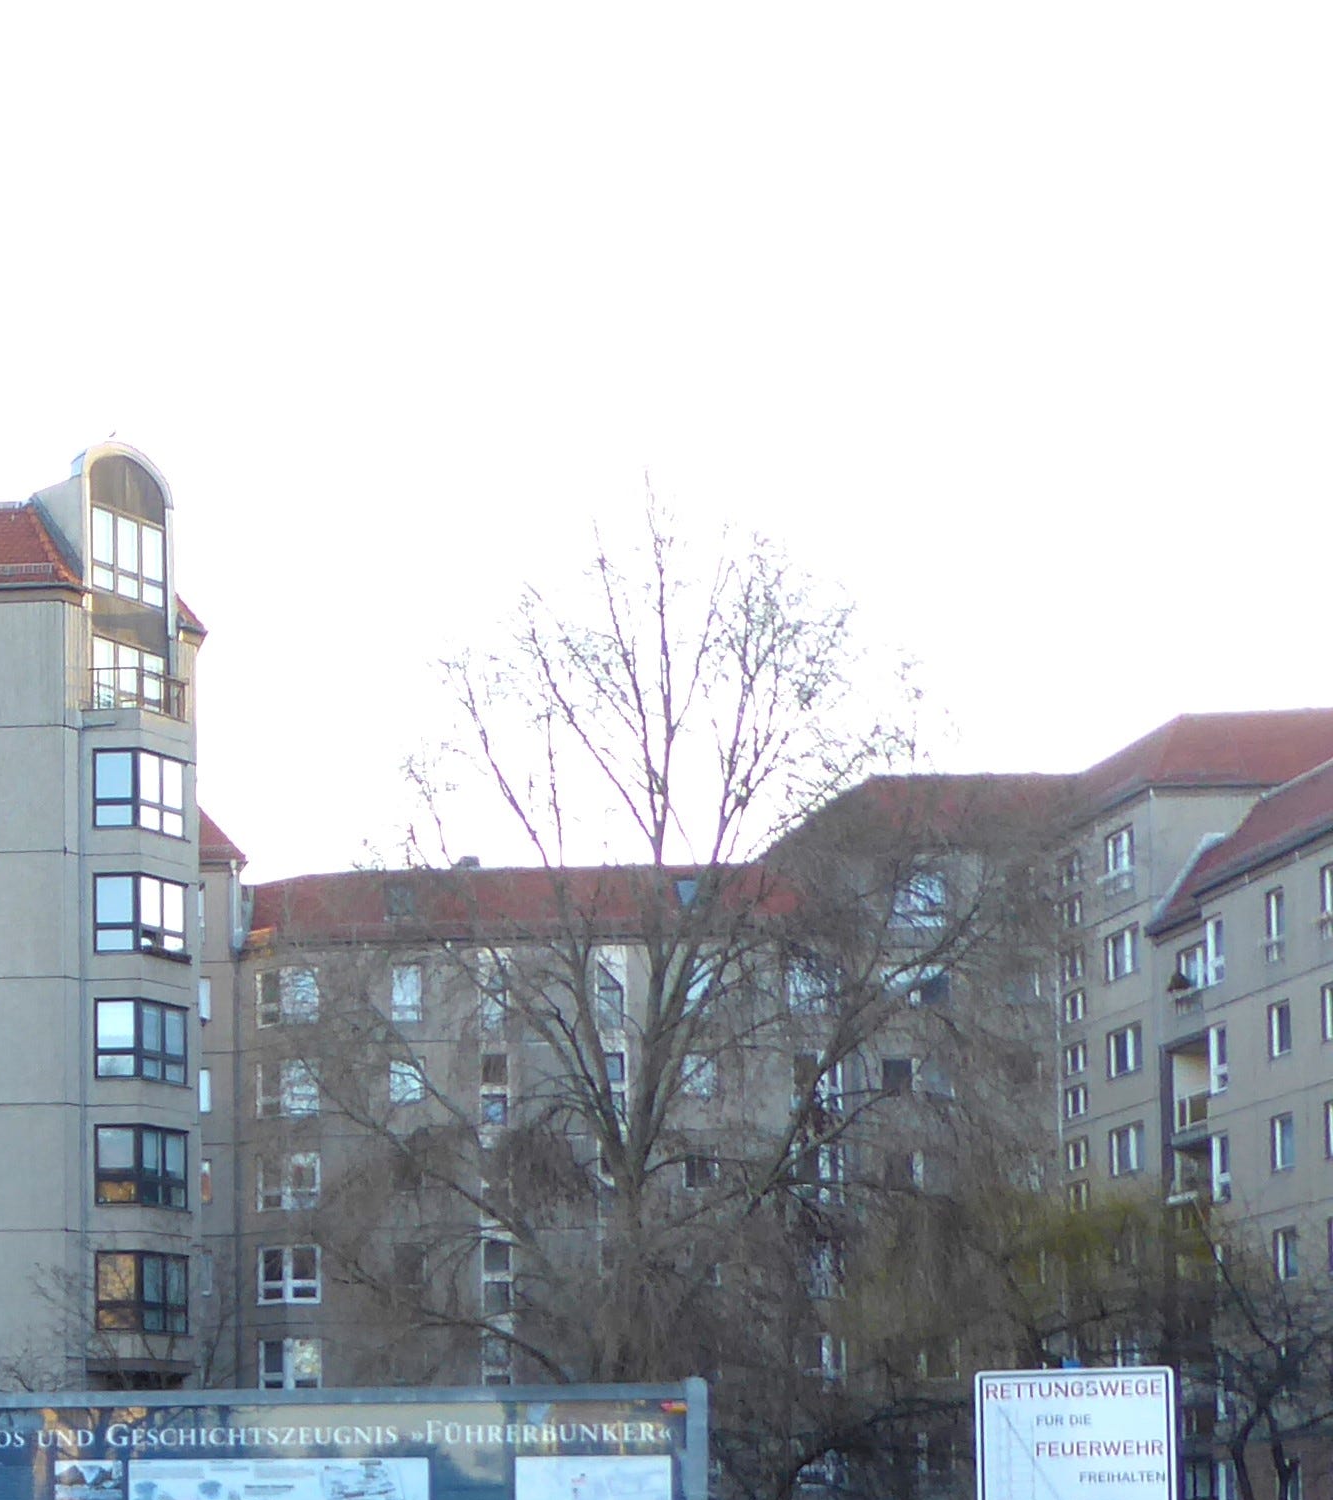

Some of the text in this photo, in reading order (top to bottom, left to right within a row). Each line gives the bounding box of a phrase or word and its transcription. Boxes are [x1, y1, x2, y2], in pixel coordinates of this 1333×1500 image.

[985, 1379, 1163, 1400] RETTUNGSWEGE
[1036, 1413, 1092, 1427] FÜR DIE
[36, 1427, 95, 1448] UND
[105, 1423, 399, 1447] GESCHICHTSZEUGNIS
[1036, 1439, 1164, 1457] FEUERWEHR
[1079, 1471, 1165, 1484] FREIHALTEN
